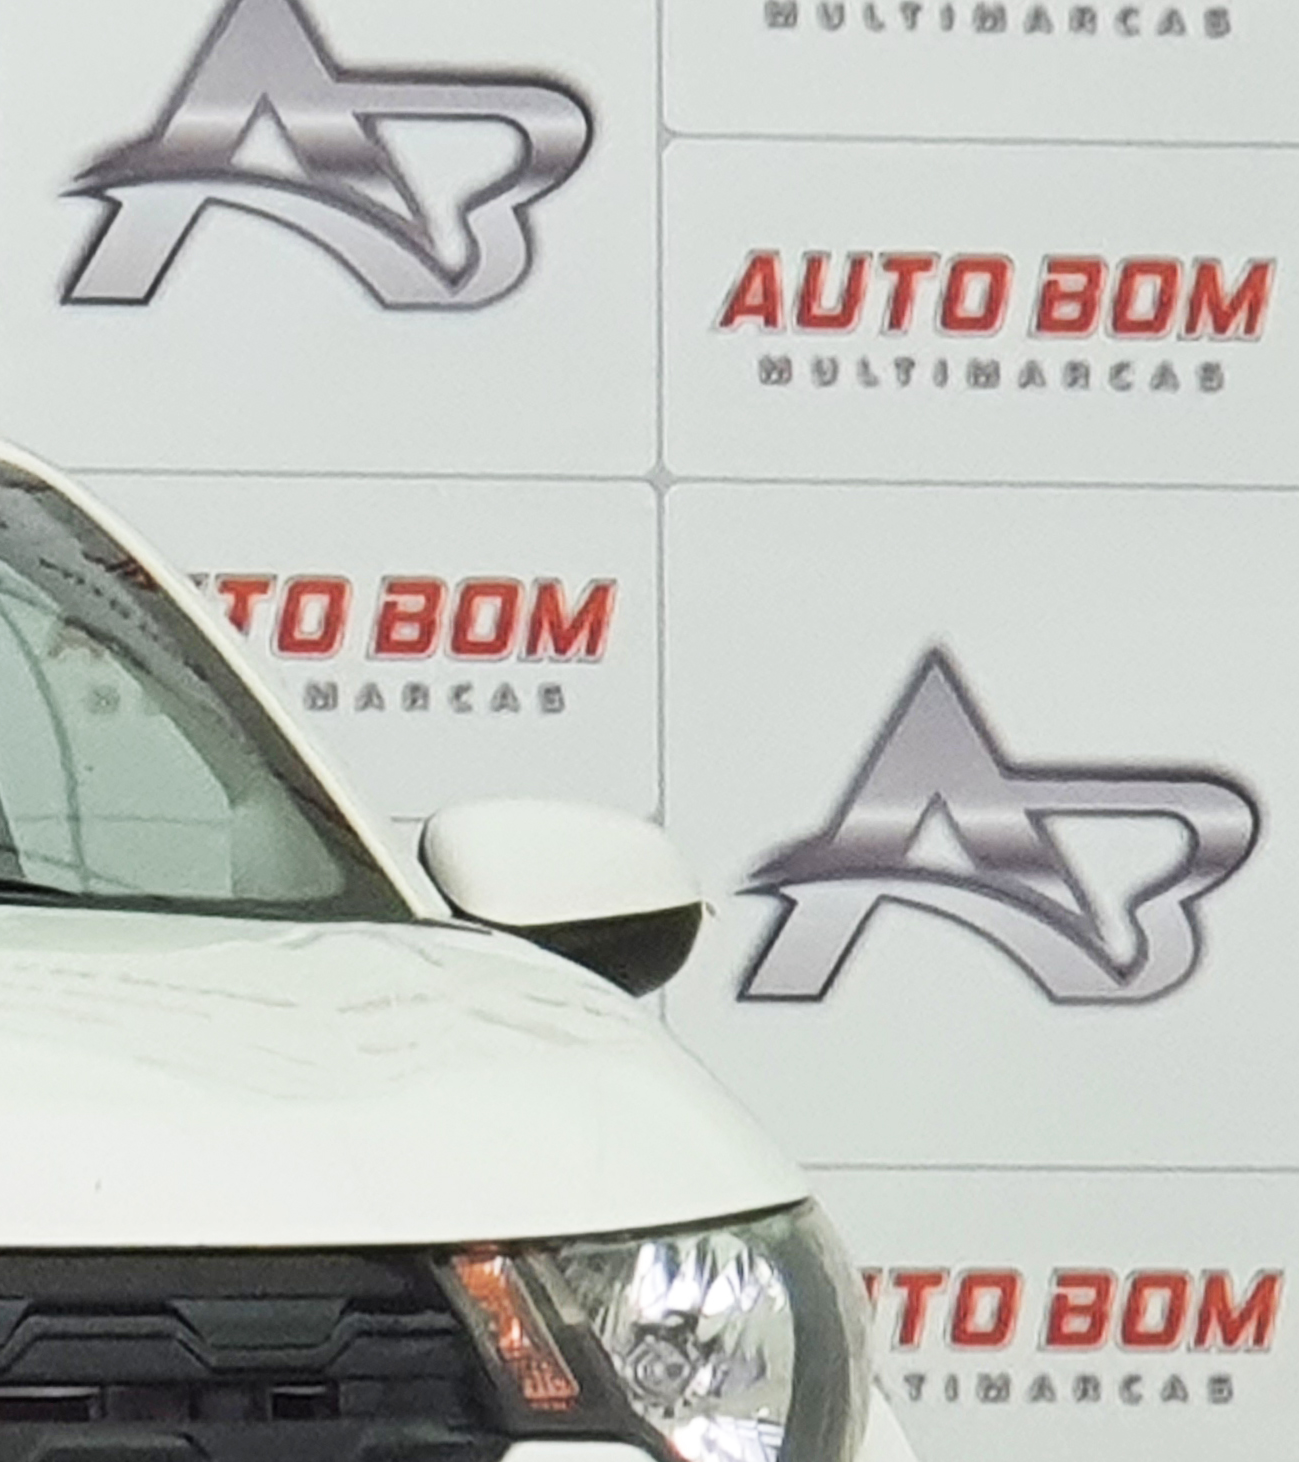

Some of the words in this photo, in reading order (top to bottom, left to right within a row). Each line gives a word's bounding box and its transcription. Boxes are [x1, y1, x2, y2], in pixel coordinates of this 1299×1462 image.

[764, 0, 1233, 38] MULTIMARCAS
[711, 249, 1014, 337] AUTO
[1028, 253, 1276, 342] BOM
[758, 354, 1226, 394] MULTIMARCAS
[188, 574, 353, 661] TO
[366, 575, 618, 662] BOM
[858, 1267, 1024, 1352] TO
[1037, 1267, 1284, 1354] BOM
